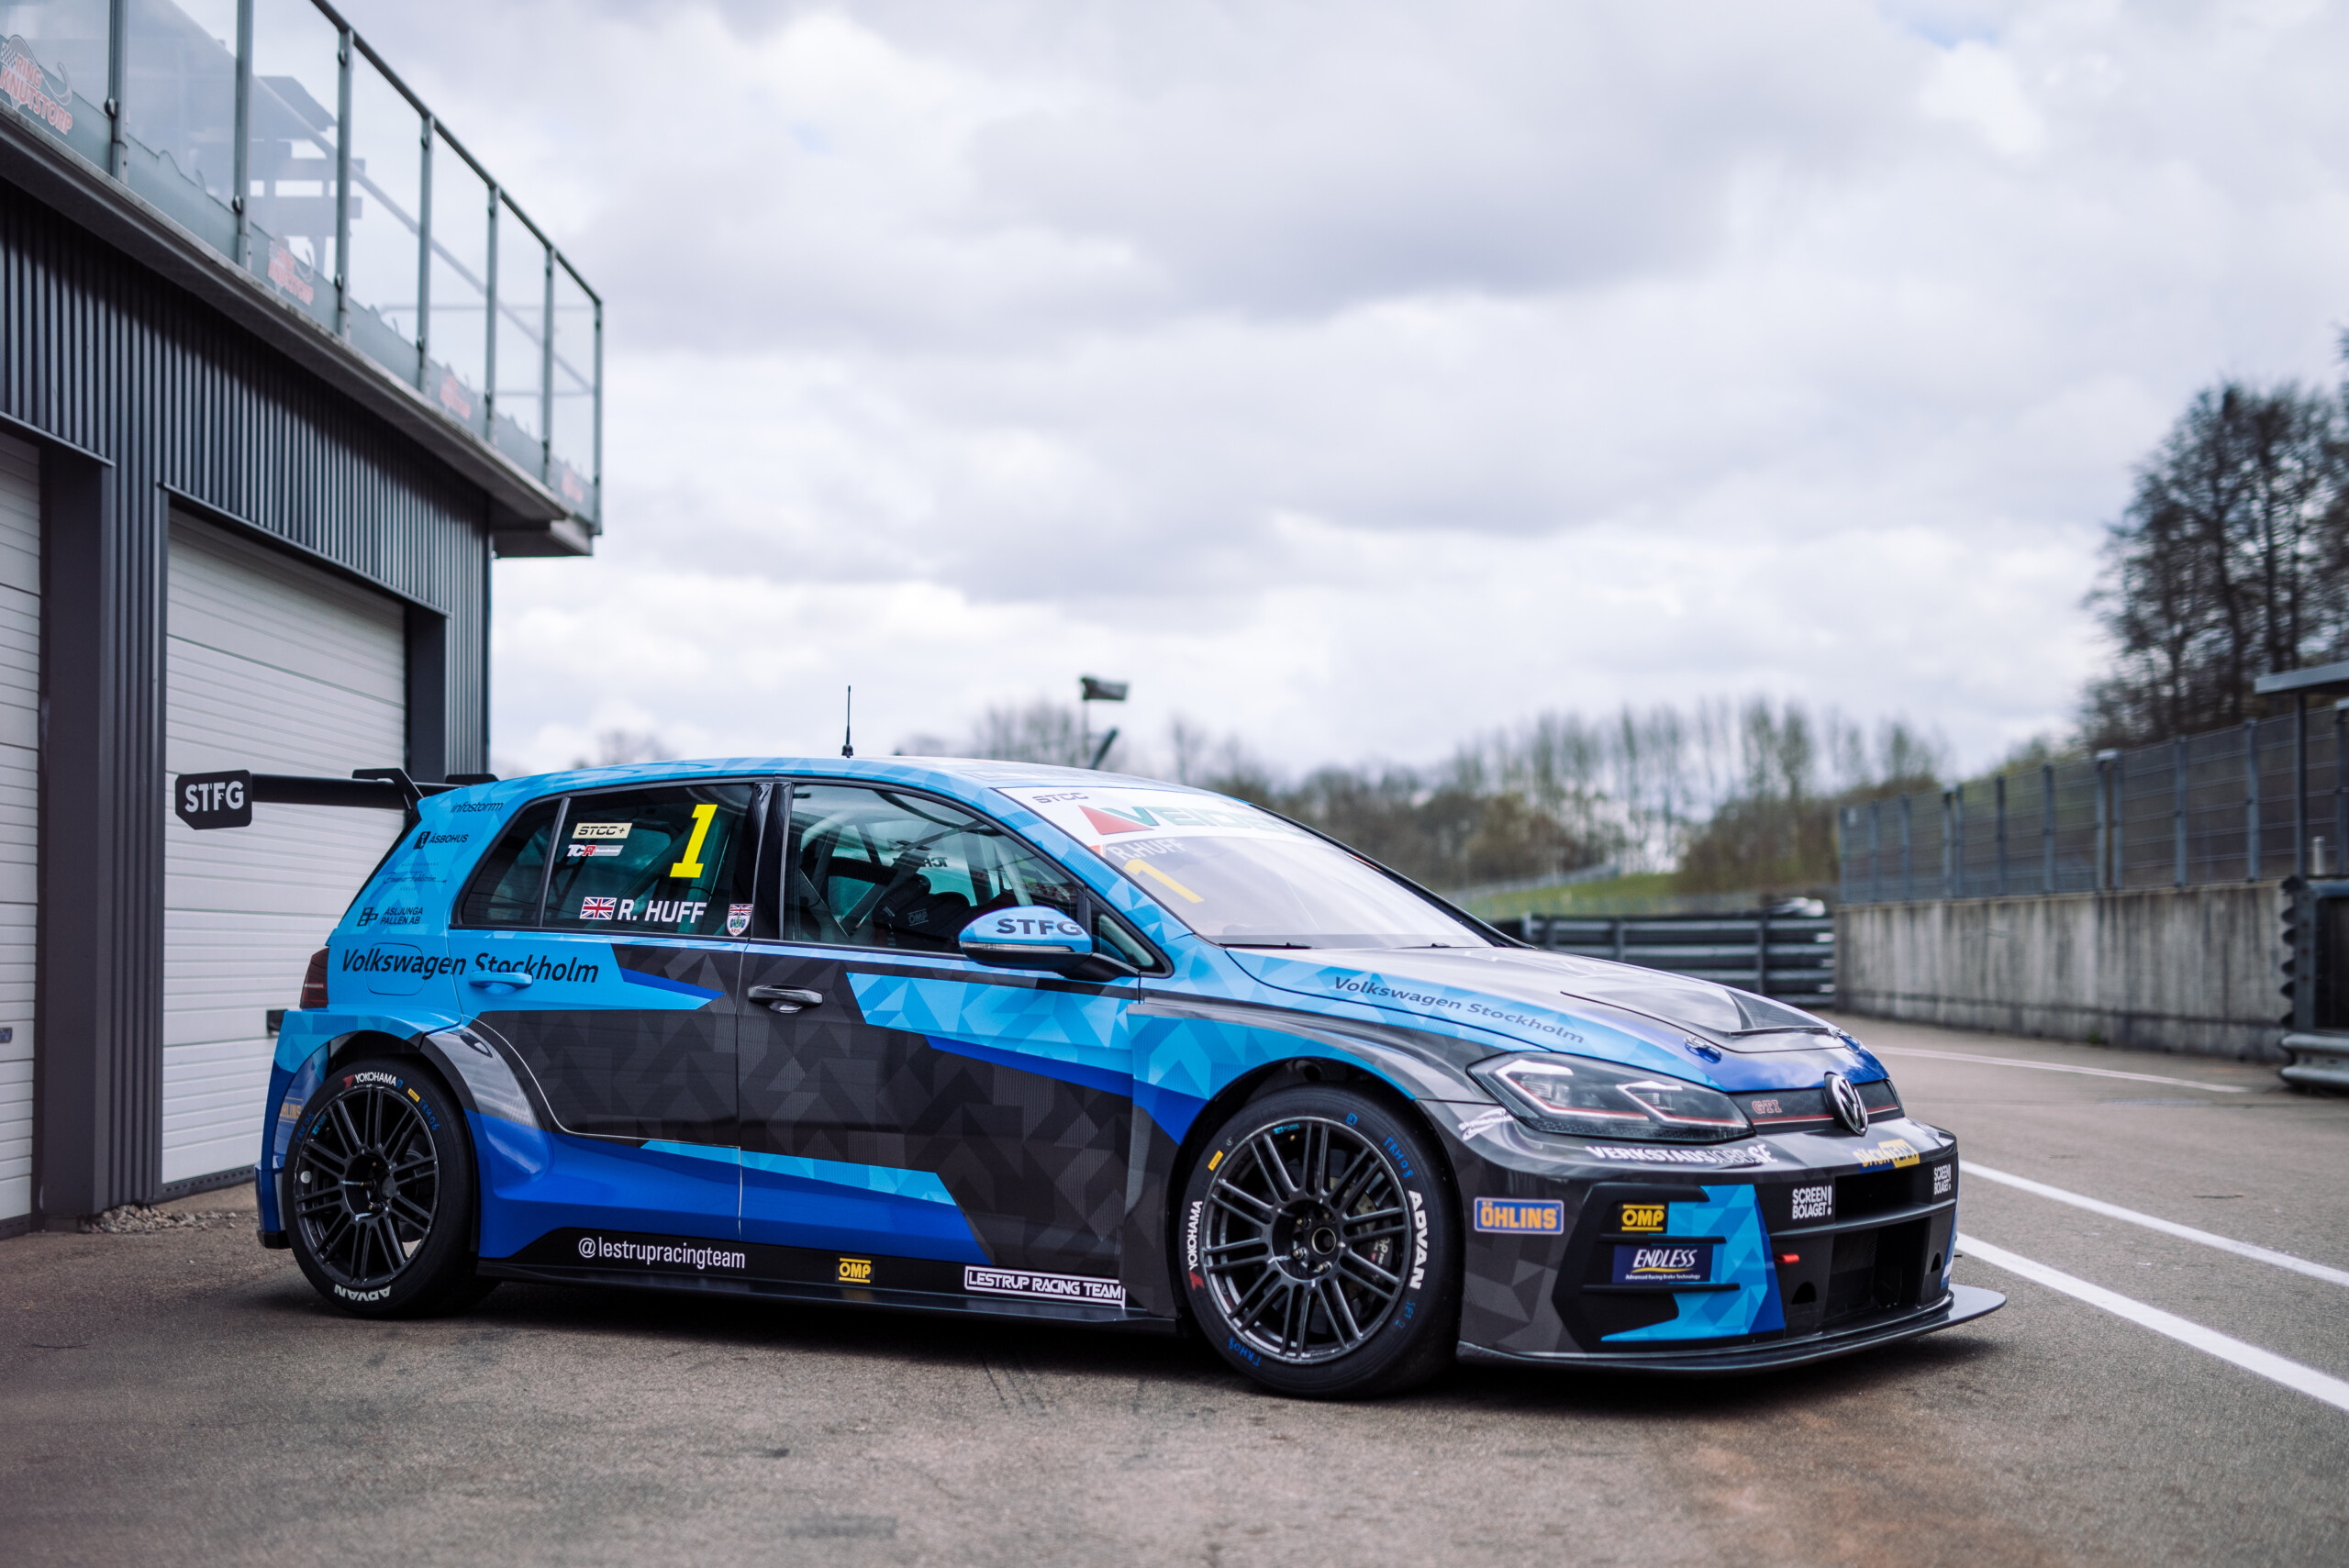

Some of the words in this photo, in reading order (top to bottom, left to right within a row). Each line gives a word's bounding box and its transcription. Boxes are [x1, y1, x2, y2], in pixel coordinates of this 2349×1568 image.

[16, 53, 42, 89] RING
[0, 65, 72, 135] KNUTSTORP
[184, 781, 244, 813] STFG
[1032, 793, 1089, 804] STCC
[429, 833, 469, 843] ÅSBOHUS
[567, 844, 596, 857] TCR
[670, 804, 718, 879] 1
[380, 917, 408, 925] PALLEN
[409, 917, 421, 925] AB
[617, 899, 638, 921] R.
[644, 900, 707, 924] HUFF
[996, 918, 1083, 936] STFG
[342, 949, 466, 980] Volkswagen
[1335, 976, 1462, 1010] Volkswagen
[1467, 1003, 1585, 1044] Stockholm
[355, 1071, 396, 1086] YOKOHAMA
[1752, 1100, 1782, 1114] GTI
[1480, 1201, 1557, 1229] ÖHLINS
[1621, 1209, 1664, 1228] OMP
[1186, 1200, 1204, 1272] YOKOHAMA
[1408, 1189, 1429, 1290] ADVAN
[578, 1237, 746, 1270] @lestrupracingteam
[1633, 1249, 1698, 1268] ENDLESS
[839, 1262, 872, 1279] OMP
[334, 1284, 392, 1302] ADVAN
[968, 1272, 1030, 1289] LESTRUP
[1031, 1278, 1081, 1296] RACING
[1083, 1282, 1122, 1299] TEAM
